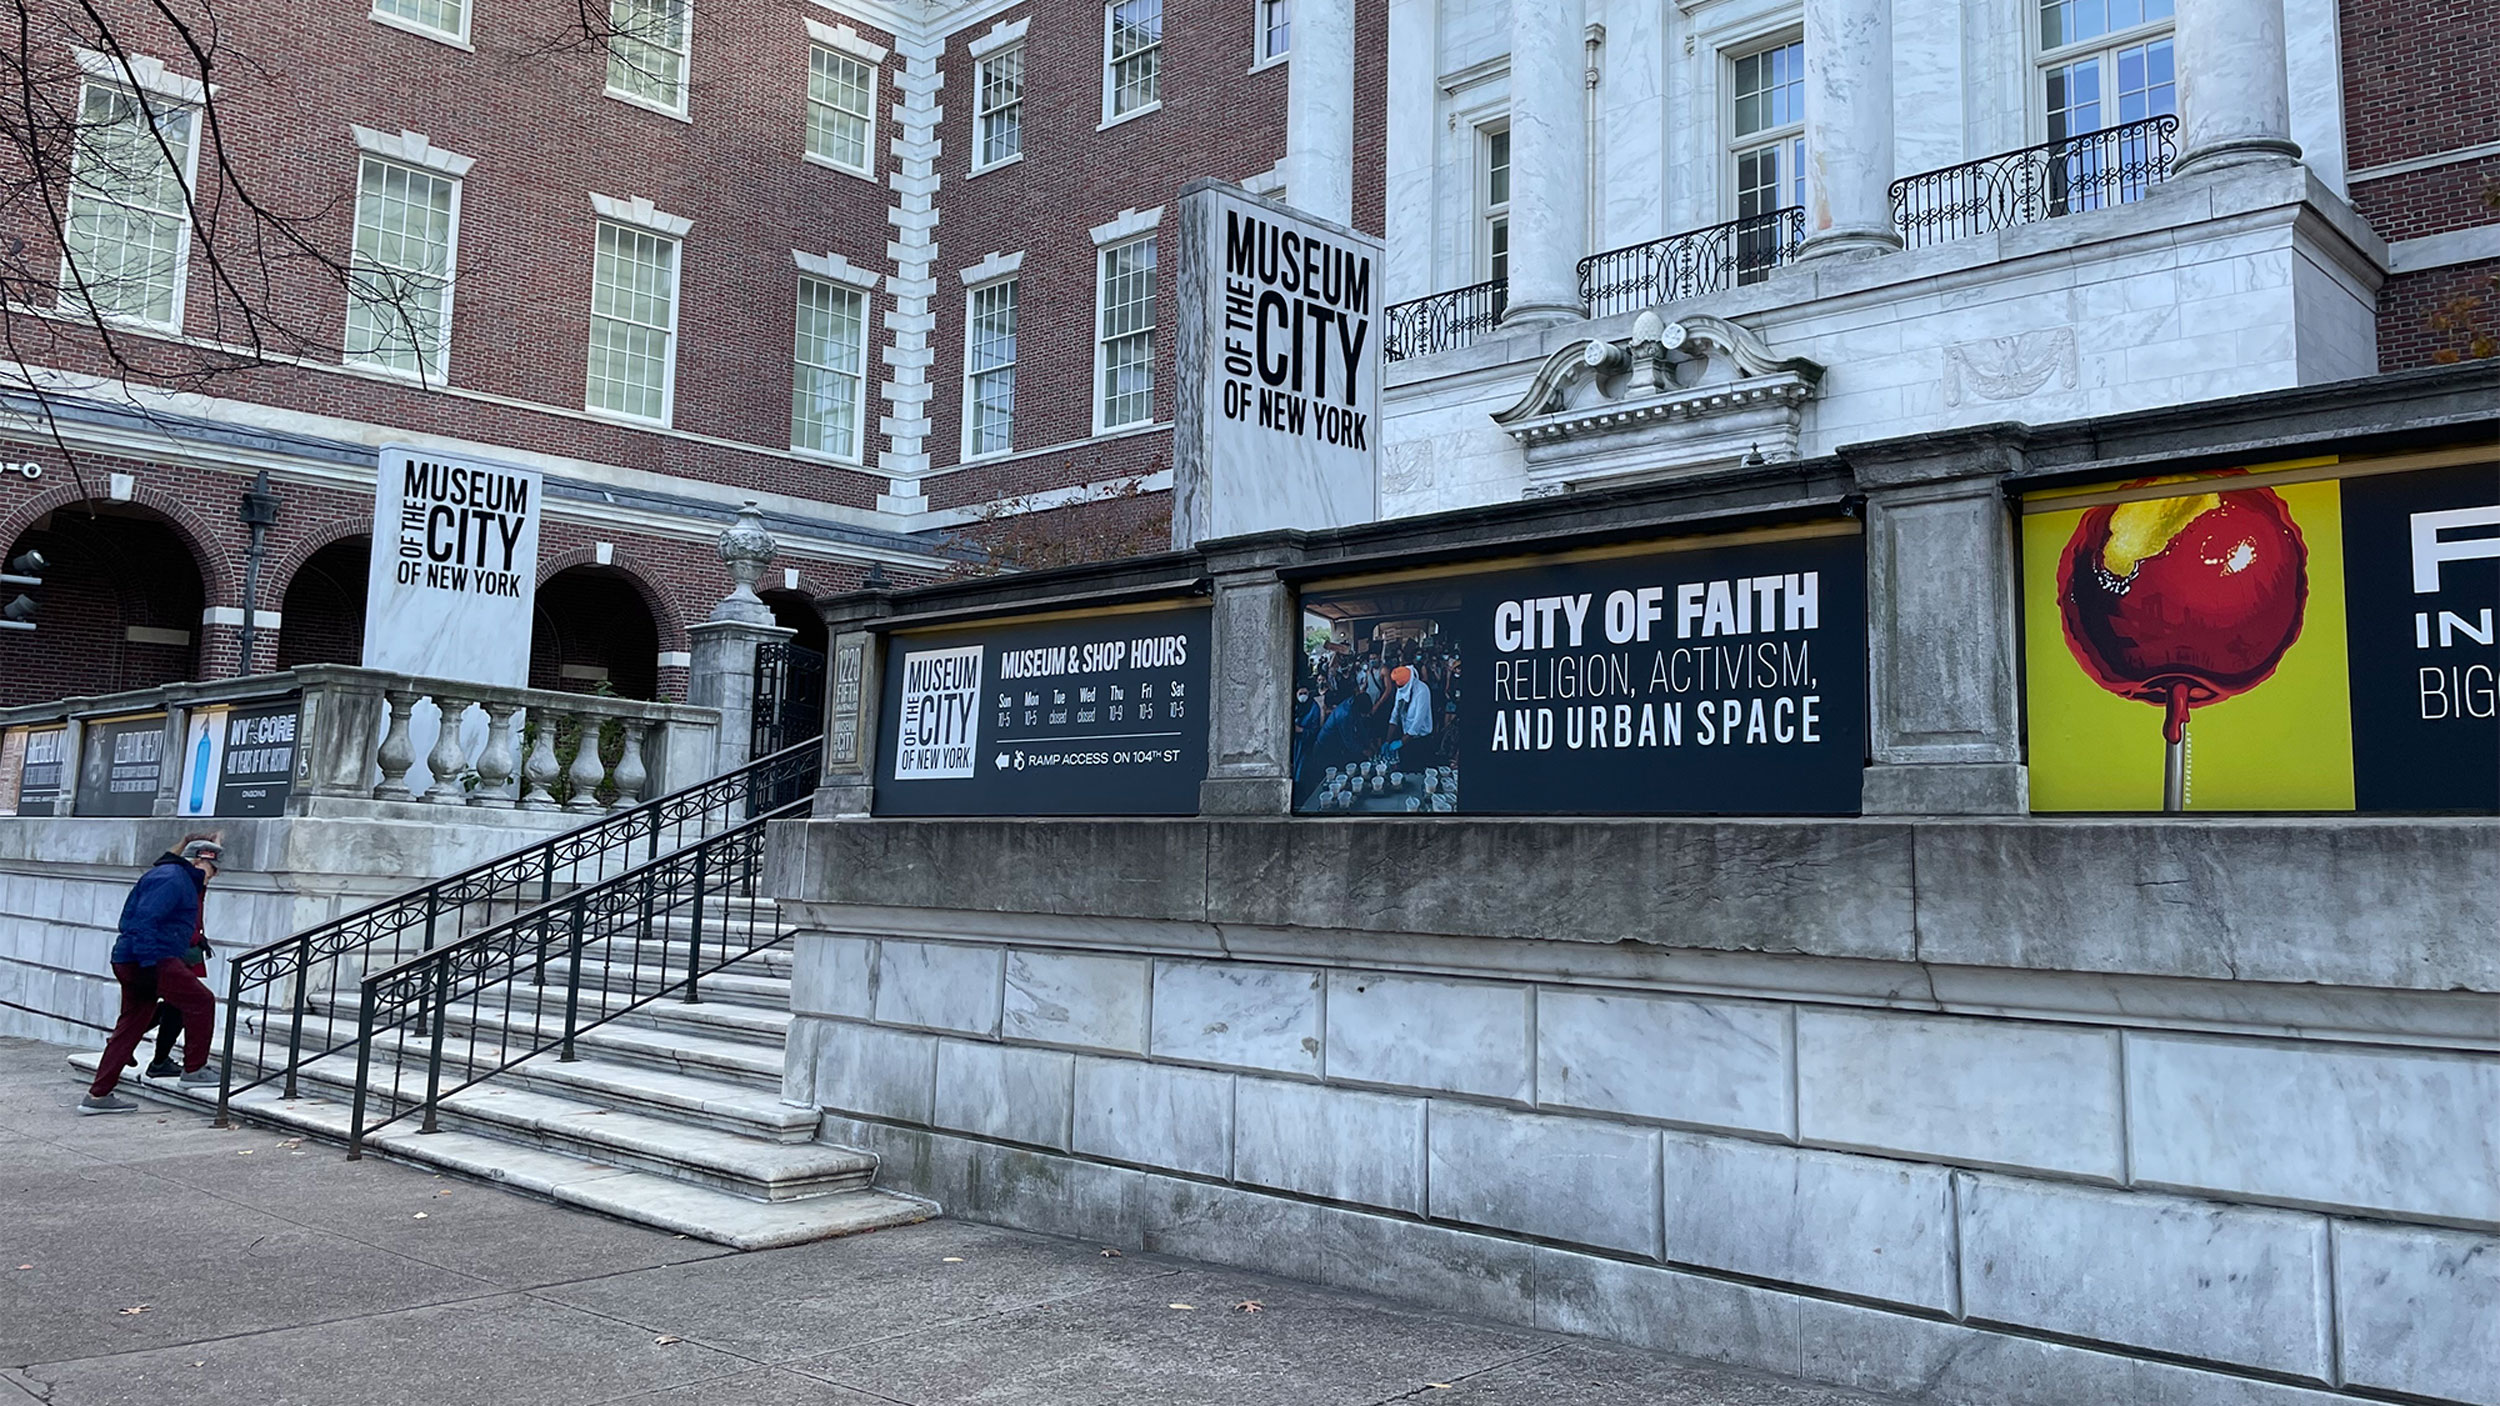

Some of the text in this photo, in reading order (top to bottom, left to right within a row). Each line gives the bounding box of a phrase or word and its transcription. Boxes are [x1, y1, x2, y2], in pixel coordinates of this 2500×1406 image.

[1227, 209, 1370, 316] MUSEUM
[1224, 277, 1254, 377] OF THE
[1256, 290, 1368, 407] CITY
[1224, 379, 1367, 452] OF NEW YORK
[404, 459, 528, 515] MUSEUM
[399, 499, 426, 558] OF THE
[427, 504, 525, 572] CITY
[397, 560, 521, 598] OF NEW YORK
[1494, 571, 1819, 652] CITY OF FAITH
[2415, 608, 2494, 648] IN
[908, 655, 977, 693] MUSEUM
[1001, 634, 1187, 679] MUSEUM & SHOP HOURS
[1495, 640, 1817, 701] RELIGION, ACTIVISM,
[918, 691, 974, 746] CITY
[998, 680, 1185, 708] Sun Mon Tue Wed Thu Fri Sat
[998, 701, 1184, 727] 10-5 10-5 closed closed 10-9 10-5 10-5
[2419, 664, 2500, 719] BIG
[258, 713, 297, 743] CORE
[904, 696, 919, 746] OF THE
[1492, 695, 1820, 751] AND URBAN SPACE
[902, 750, 914, 770] OF
[916, 748, 940, 769] NEW
[1028, 753, 1061, 766] RAMP
[1061, 752, 1109, 765] ACCESS
[1112, 751, 1131, 764] ON
[1163, 750, 1180, 762] ST
